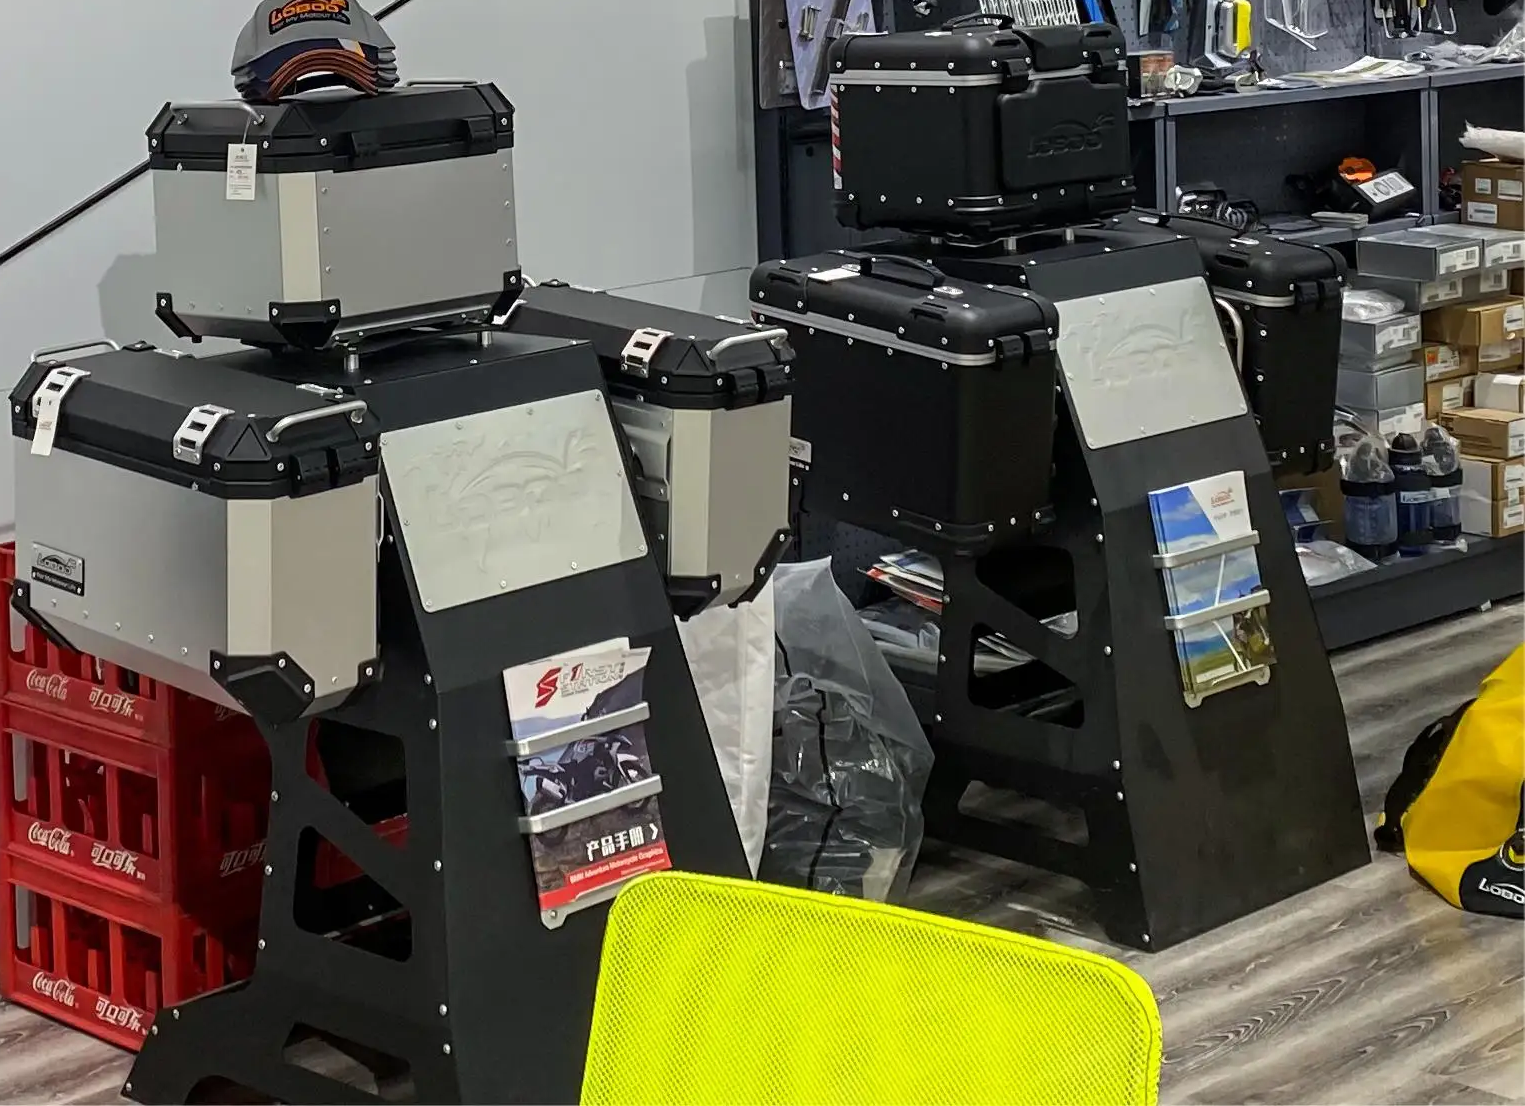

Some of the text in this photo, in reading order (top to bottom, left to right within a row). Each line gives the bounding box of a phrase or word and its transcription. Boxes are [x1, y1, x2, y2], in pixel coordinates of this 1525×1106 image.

[91, 842, 139, 877] 可口可乐
[586, 825, 645, 862] 产品手册
[95, 996, 144, 1032] 可口可乐
